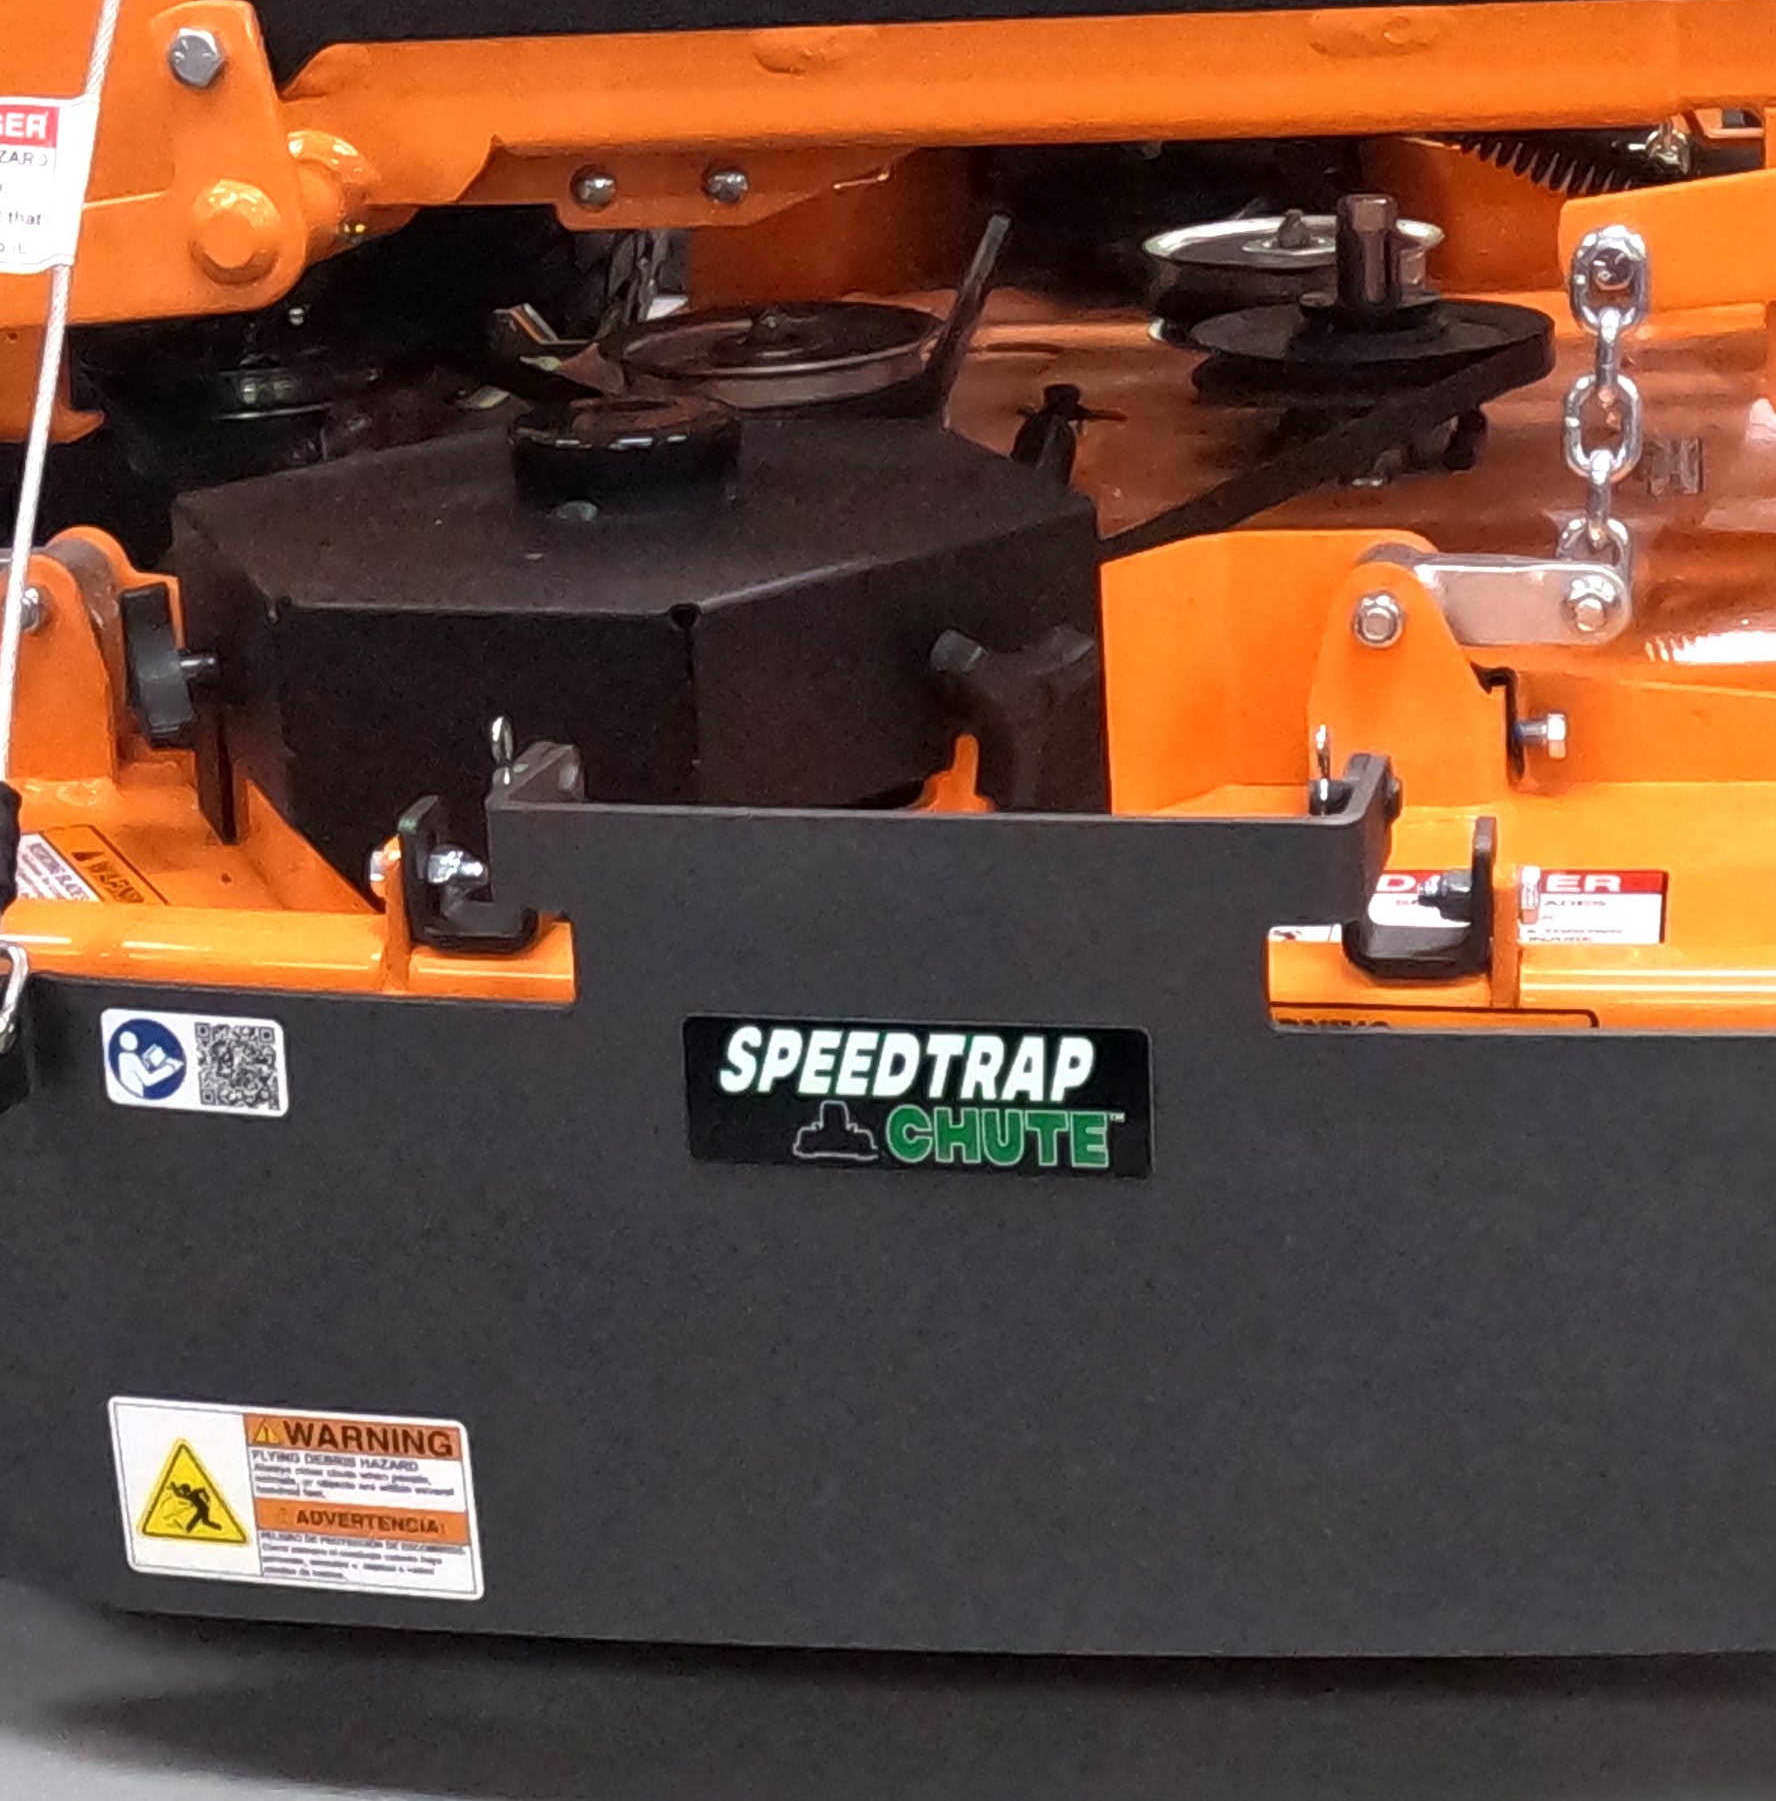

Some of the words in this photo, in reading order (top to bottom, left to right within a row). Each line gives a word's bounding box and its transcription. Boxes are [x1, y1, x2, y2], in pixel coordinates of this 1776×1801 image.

[719, 1025, 1095, 1102] SPEEDTRAP
[885, 1103, 1111, 1168] CHUTE
[251, 1449, 300, 1464] FLYING
[360, 1457, 419, 1471] HAZARD
[284, 1420, 453, 1457] WARNING
